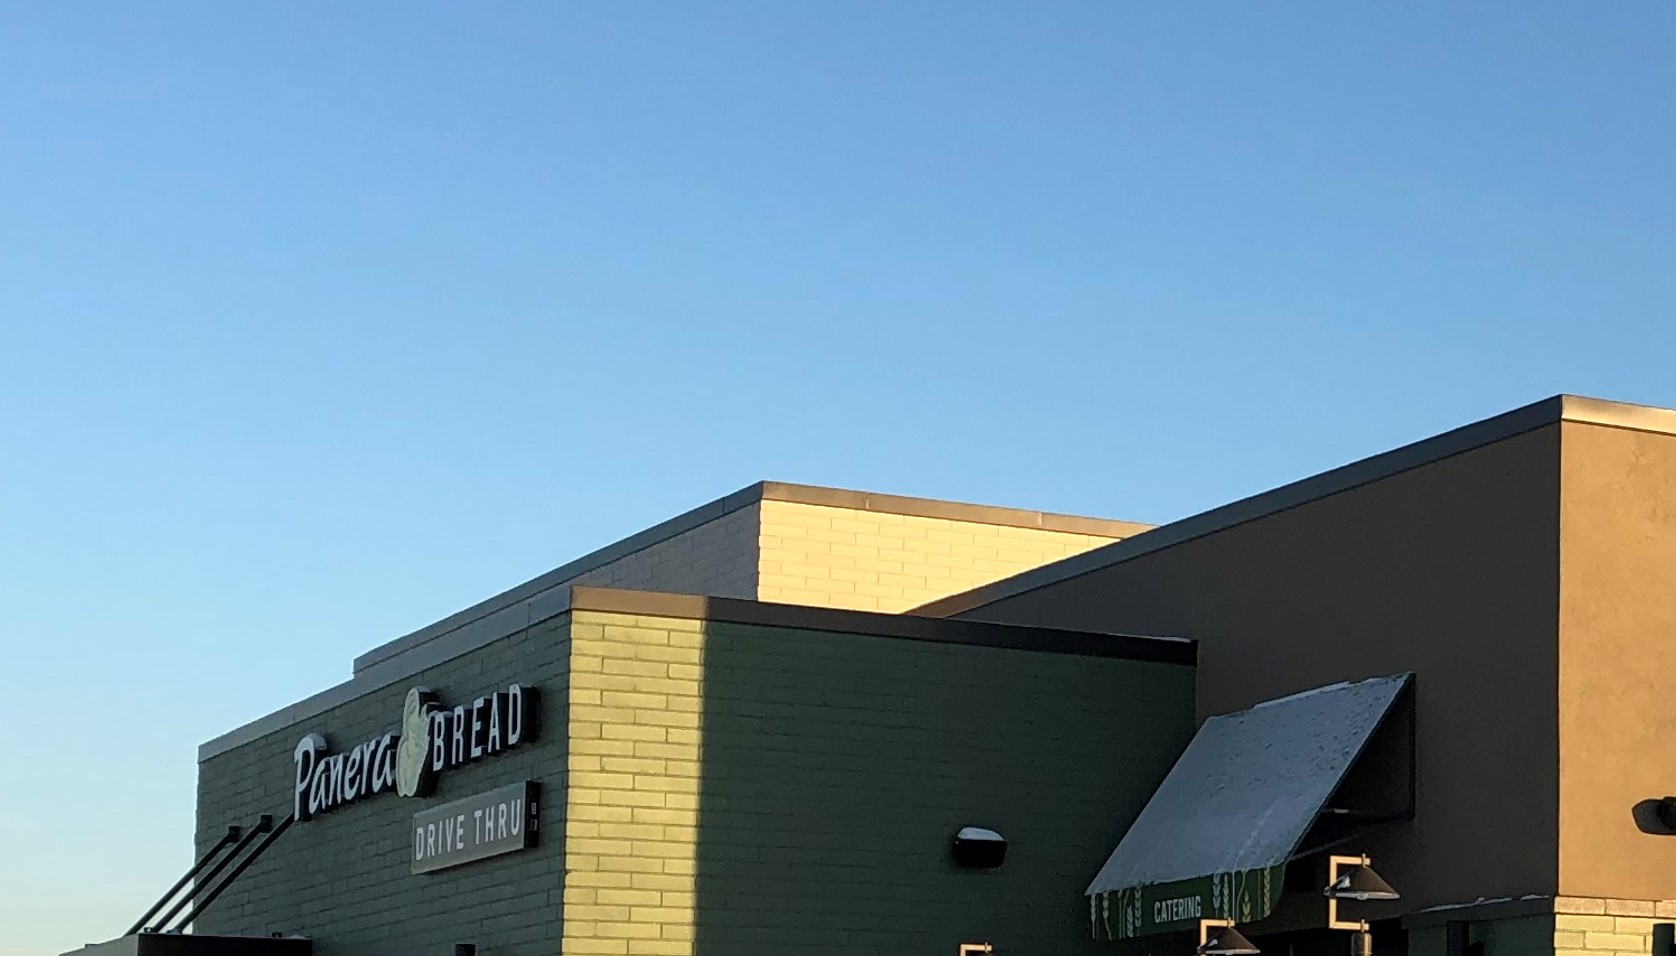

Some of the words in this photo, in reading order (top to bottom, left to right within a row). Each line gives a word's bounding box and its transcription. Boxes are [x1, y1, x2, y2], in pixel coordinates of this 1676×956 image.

[293, 735, 393, 822] Panera
[432, 683, 523, 772] BREAD
[414, 814, 465, 861] DRIVE
[473, 798, 522, 845] THRU
[1153, 895, 1202, 924] CATERING
